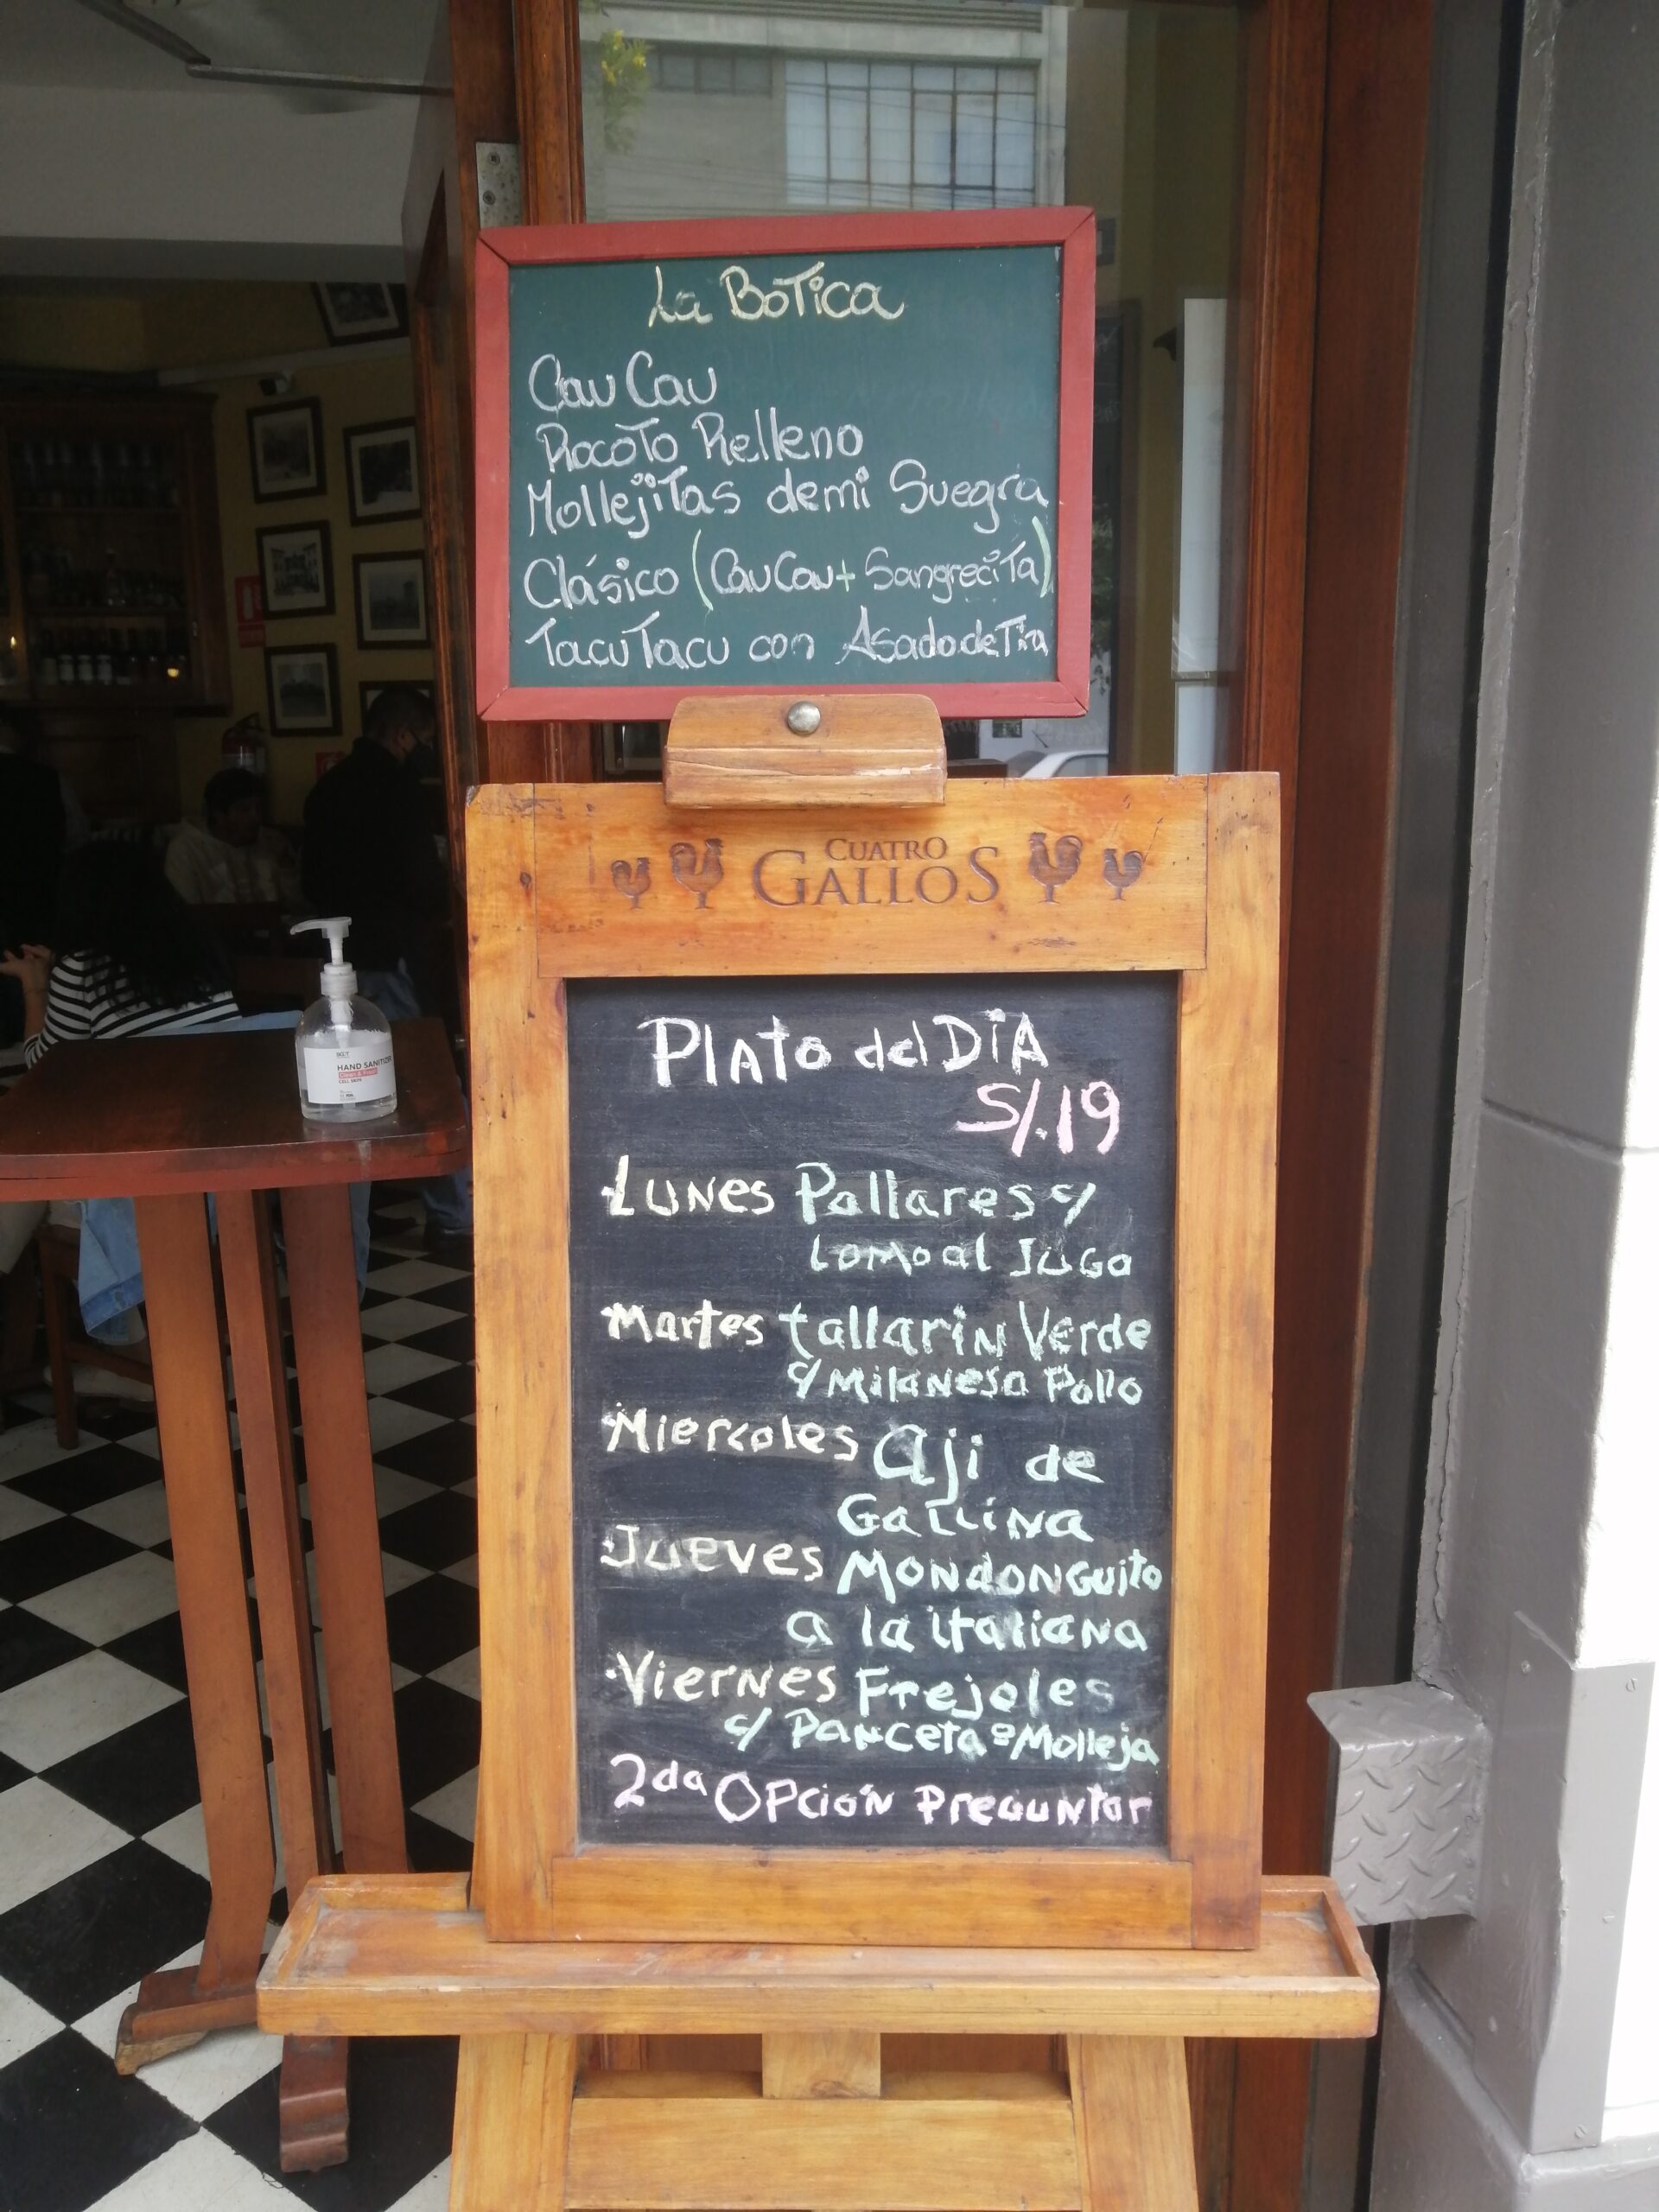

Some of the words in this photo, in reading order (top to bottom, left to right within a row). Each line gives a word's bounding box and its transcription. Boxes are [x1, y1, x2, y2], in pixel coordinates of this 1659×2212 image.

[648, 265, 713, 327] La
[691, 406, 865, 466] Relleno
[889, 459, 1049, 535] Suegra
[523, 552, 679, 610] Clásico
[747, 631, 815, 663] con
[753, 846, 999, 906] GALLOS
[824, 836, 947, 861] CUATRO
[337, 1063, 362, 1071] HAND
[796, 1162, 1035, 1226] Pallares
[602, 1299, 765, 1349] Martes
[1018, 1300, 1152, 1362] Verde
[1044, 1364, 1143, 1406] Pollo
[602, 1402, 859, 1462] Miercoles
[1026, 1445, 1105, 1484] de
[601, 1524, 823, 1581] Jueves
[855, 1666, 1116, 1719] Frejoles
[610, 1752, 708, 1808] 2da
